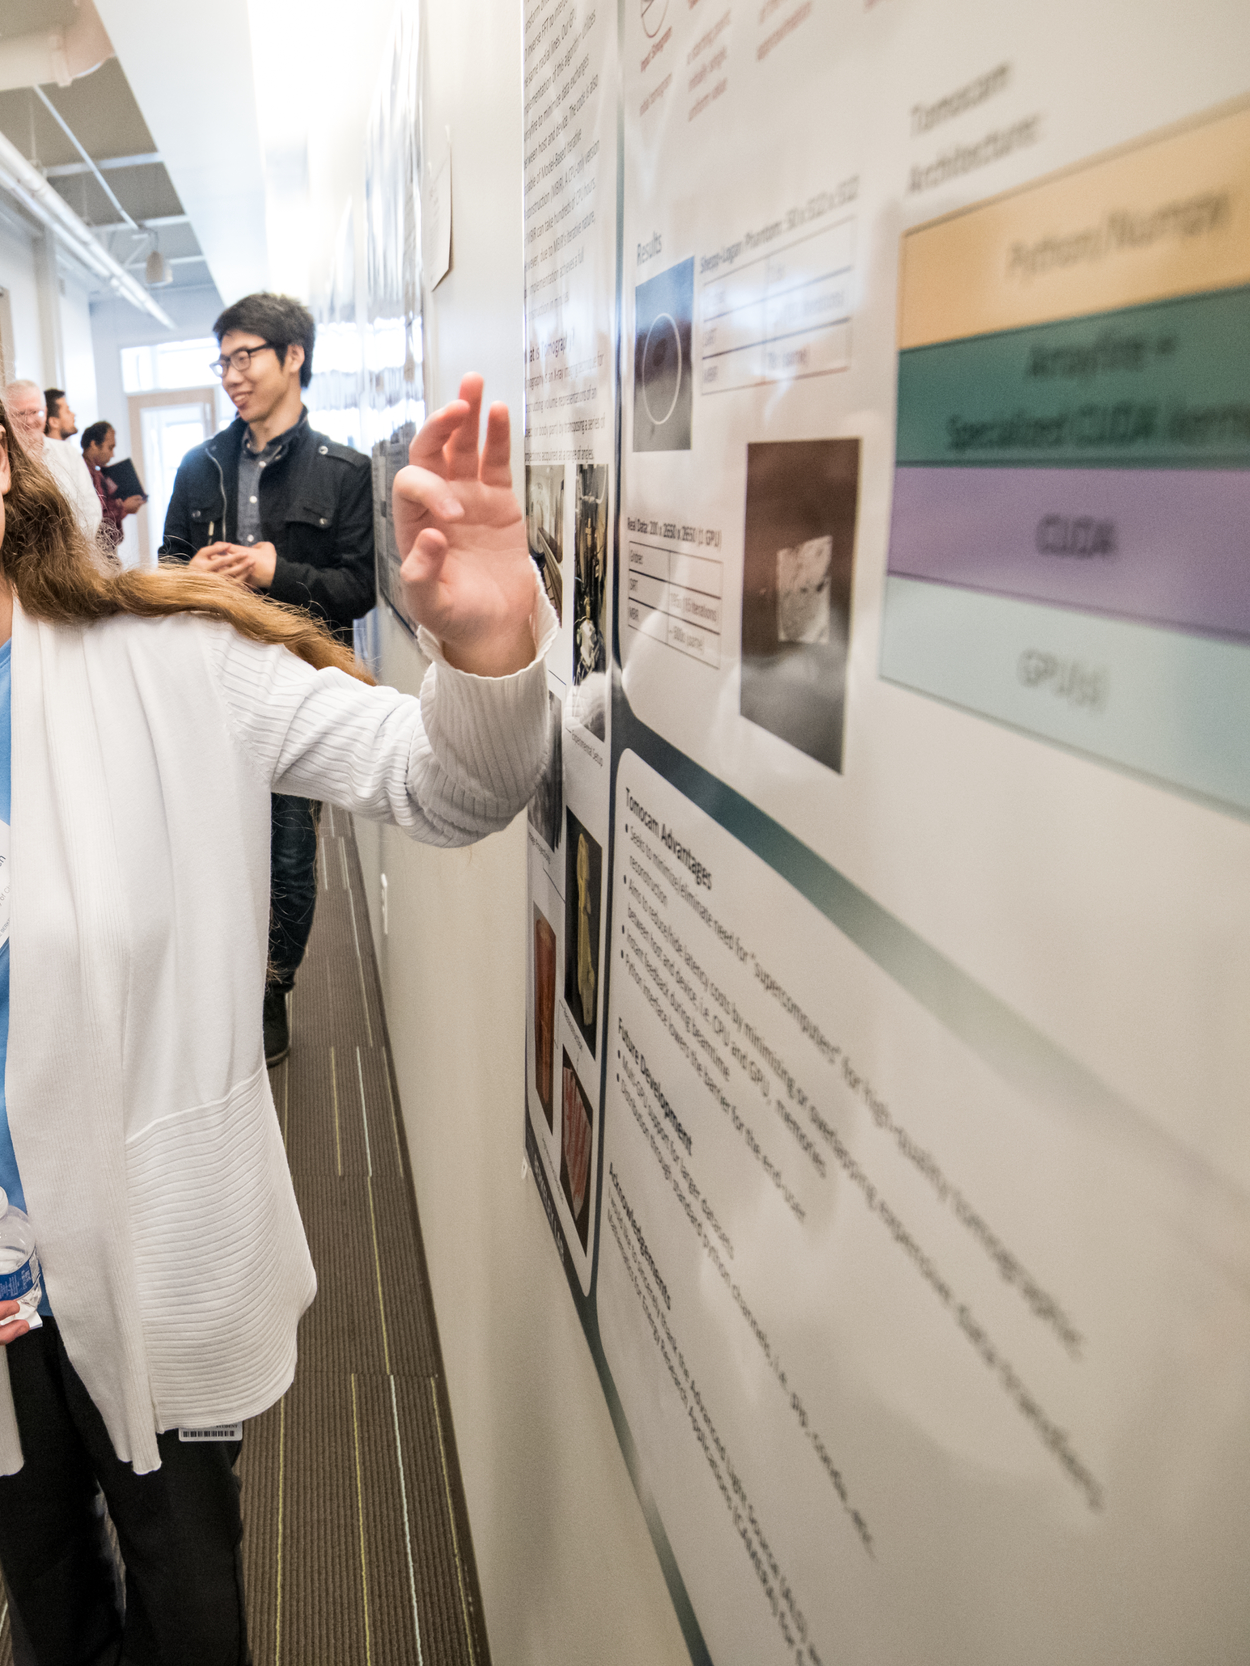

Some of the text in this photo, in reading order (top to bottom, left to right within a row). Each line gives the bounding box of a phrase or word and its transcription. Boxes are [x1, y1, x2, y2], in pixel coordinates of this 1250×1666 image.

[637, 231, 662, 265] Results
[626, 786, 712, 891] Tomocam Advantages
[618, 1016, 692, 1157] Future Development
[609, 1162, 671, 1310] Acknowledgements
